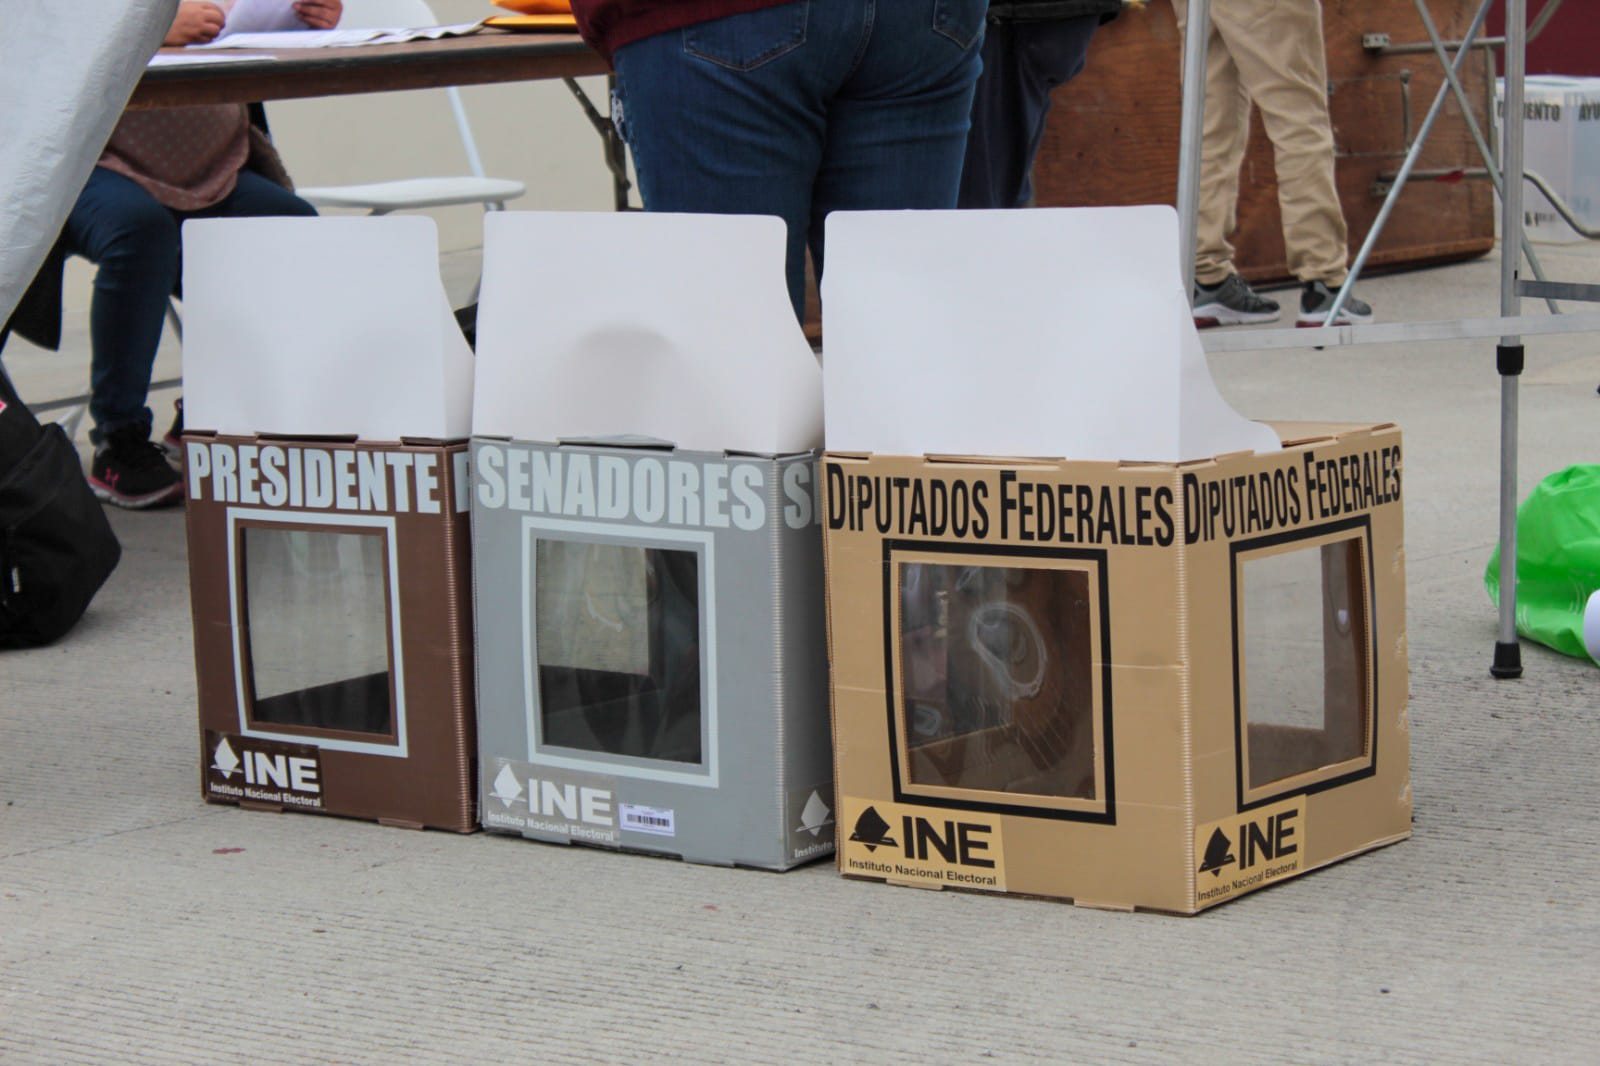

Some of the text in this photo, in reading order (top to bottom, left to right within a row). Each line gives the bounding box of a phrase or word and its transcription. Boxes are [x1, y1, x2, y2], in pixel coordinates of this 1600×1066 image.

[186, 442, 441, 514] PRESIDENTE
[477, 445, 766, 531] SENADORES
[783, 461, 821, 530] S
[826, 462, 1175, 547] DIPUTADOS FEDERALES
[1182, 445, 1401, 545] DIPUTADOS FEDERALES
[210, 782, 321, 807] Instituto Nacional Electoral
[242, 750, 320, 793] INE
[488, 810, 613, 841] Instituto Nacional Electoral
[528, 778, 613, 826] INE
[902, 815, 995, 869] INE
[1239, 808, 1298, 871] INE
[849, 858, 997, 886] Instituto Nacional Electoral
[1198, 861, 1297, 901] Instituto Nacional Electoral
